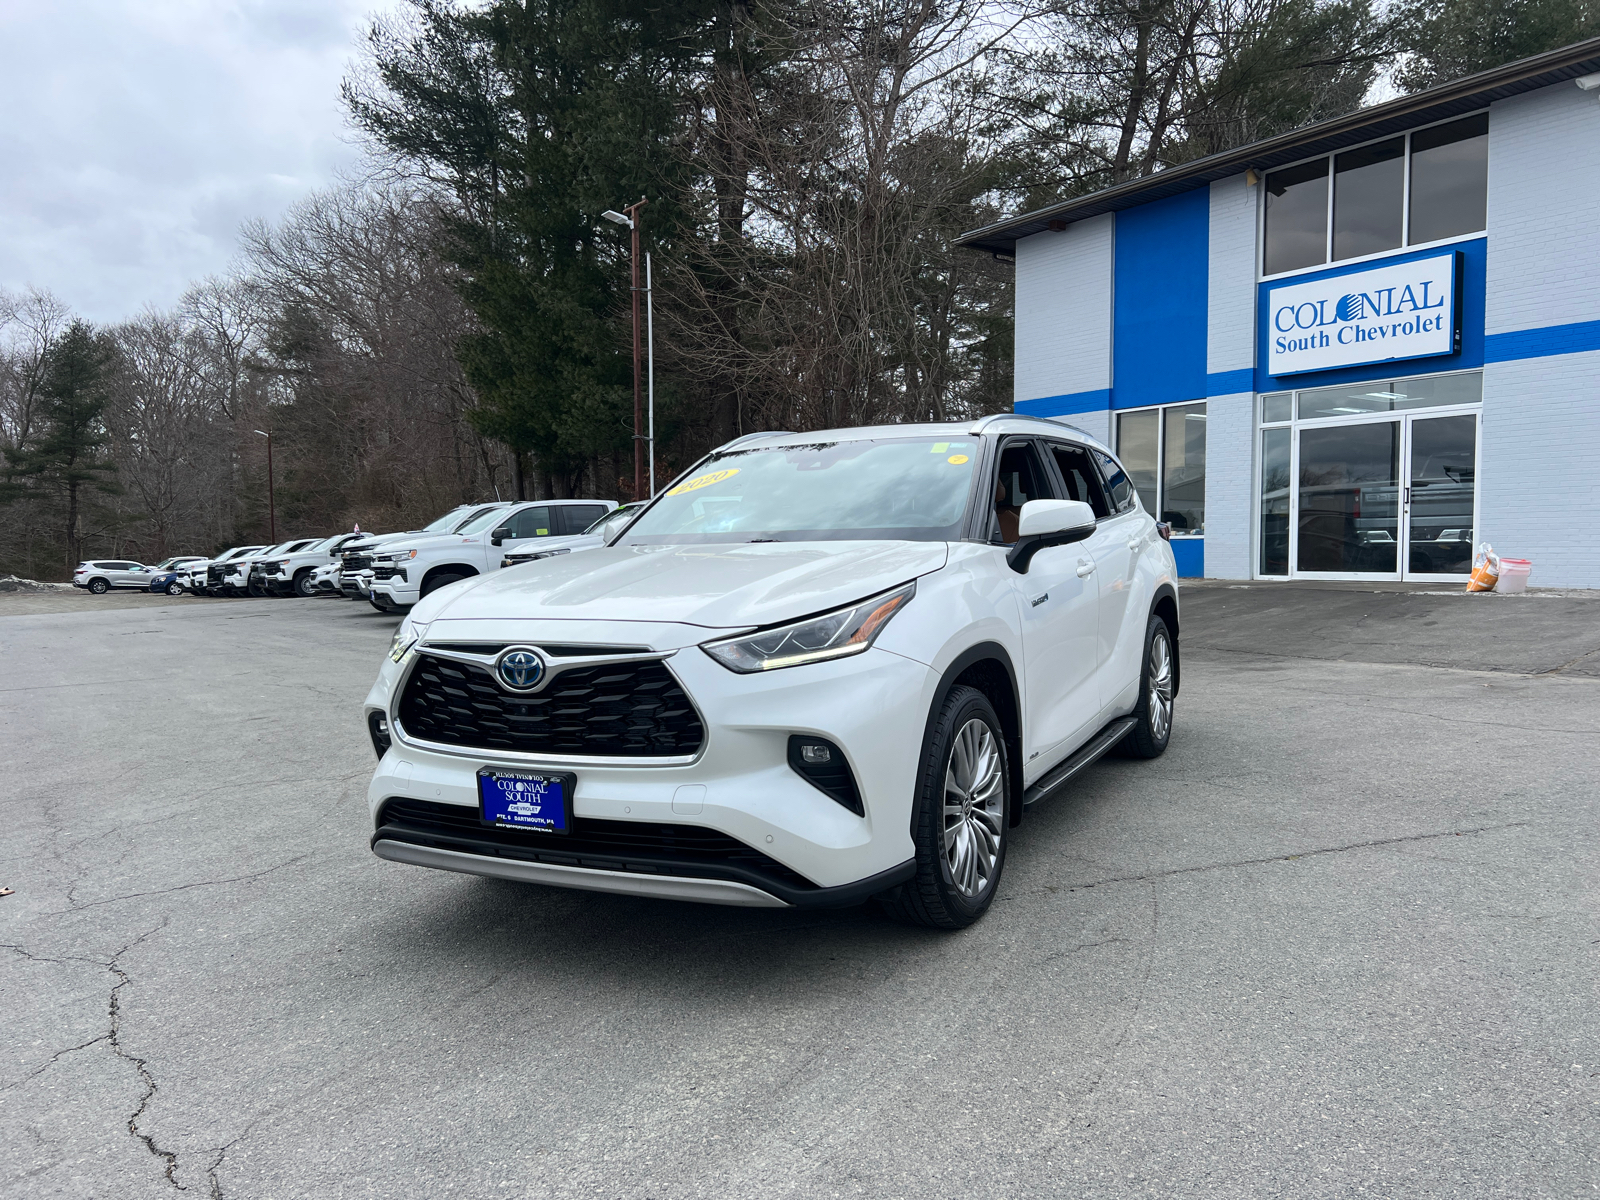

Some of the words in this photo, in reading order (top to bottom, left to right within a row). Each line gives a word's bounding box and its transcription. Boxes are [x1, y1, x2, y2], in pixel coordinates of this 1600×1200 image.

[1275, 281, 1444, 333] COLONIAL
[1275, 331, 1330, 354] South
[1337, 313, 1444, 345] Chevrolet
[676, 471, 728, 494] 2020
[497, 780, 548, 794] COLONIAL
[505, 791, 541, 803] SOUTH
